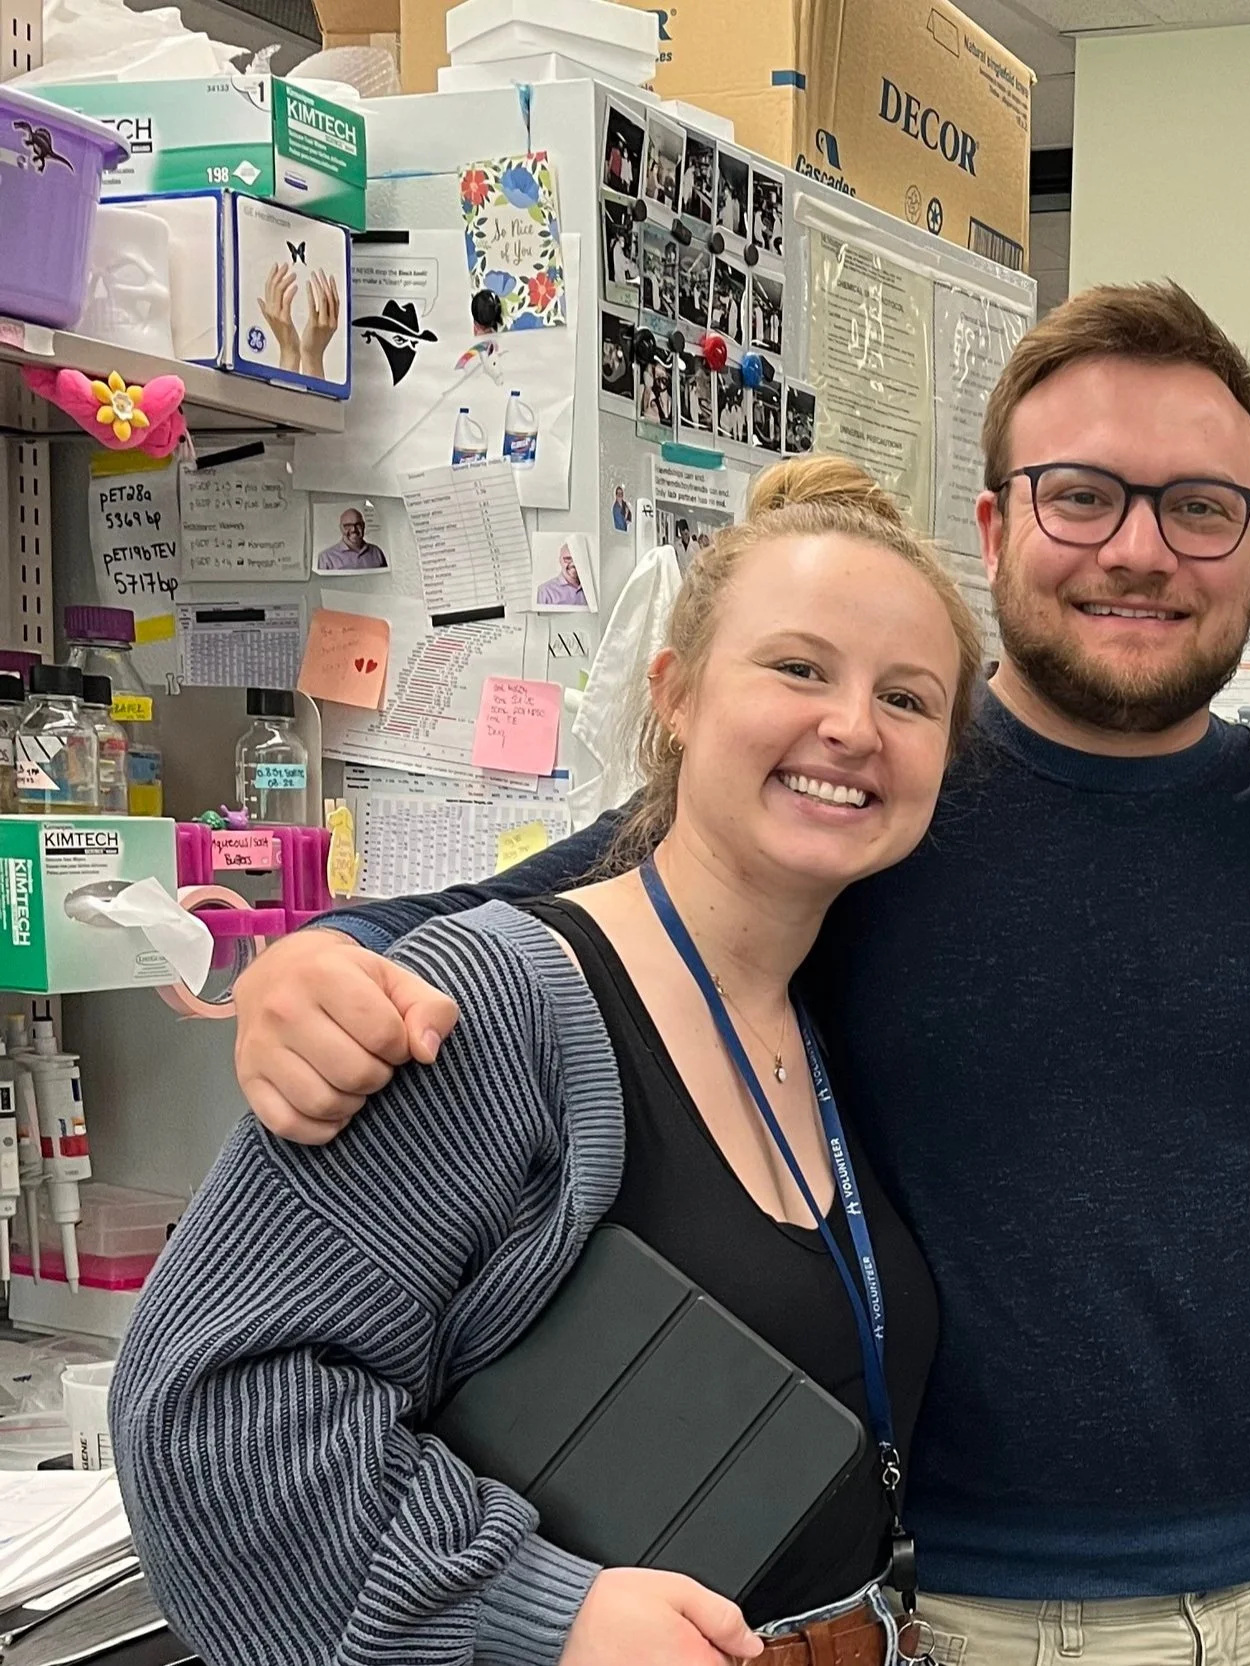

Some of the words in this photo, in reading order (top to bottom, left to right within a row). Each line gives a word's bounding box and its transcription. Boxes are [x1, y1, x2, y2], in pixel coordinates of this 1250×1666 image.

[286, 97, 357, 145] KIMTECH
[878, 76, 977, 177] DECOR
[206, 167, 229, 183] 198
[491, 217, 507, 243] So
[511, 218, 534, 237] Nice
[500, 241, 510, 264] of
[512, 240, 532, 266] You
[106, 511, 142, 529] 5369
[145, 510, 161, 531] bp
[114, 572, 156, 594] 5717
[157, 571, 178, 601] bp
[44, 832, 119, 847] KIMTECH
[14, 858, 31, 946] KIMTECH
[830, 1137, 854, 1199] VOLUNTEER
[862, 1256, 881, 1320] VOLUNTEER
